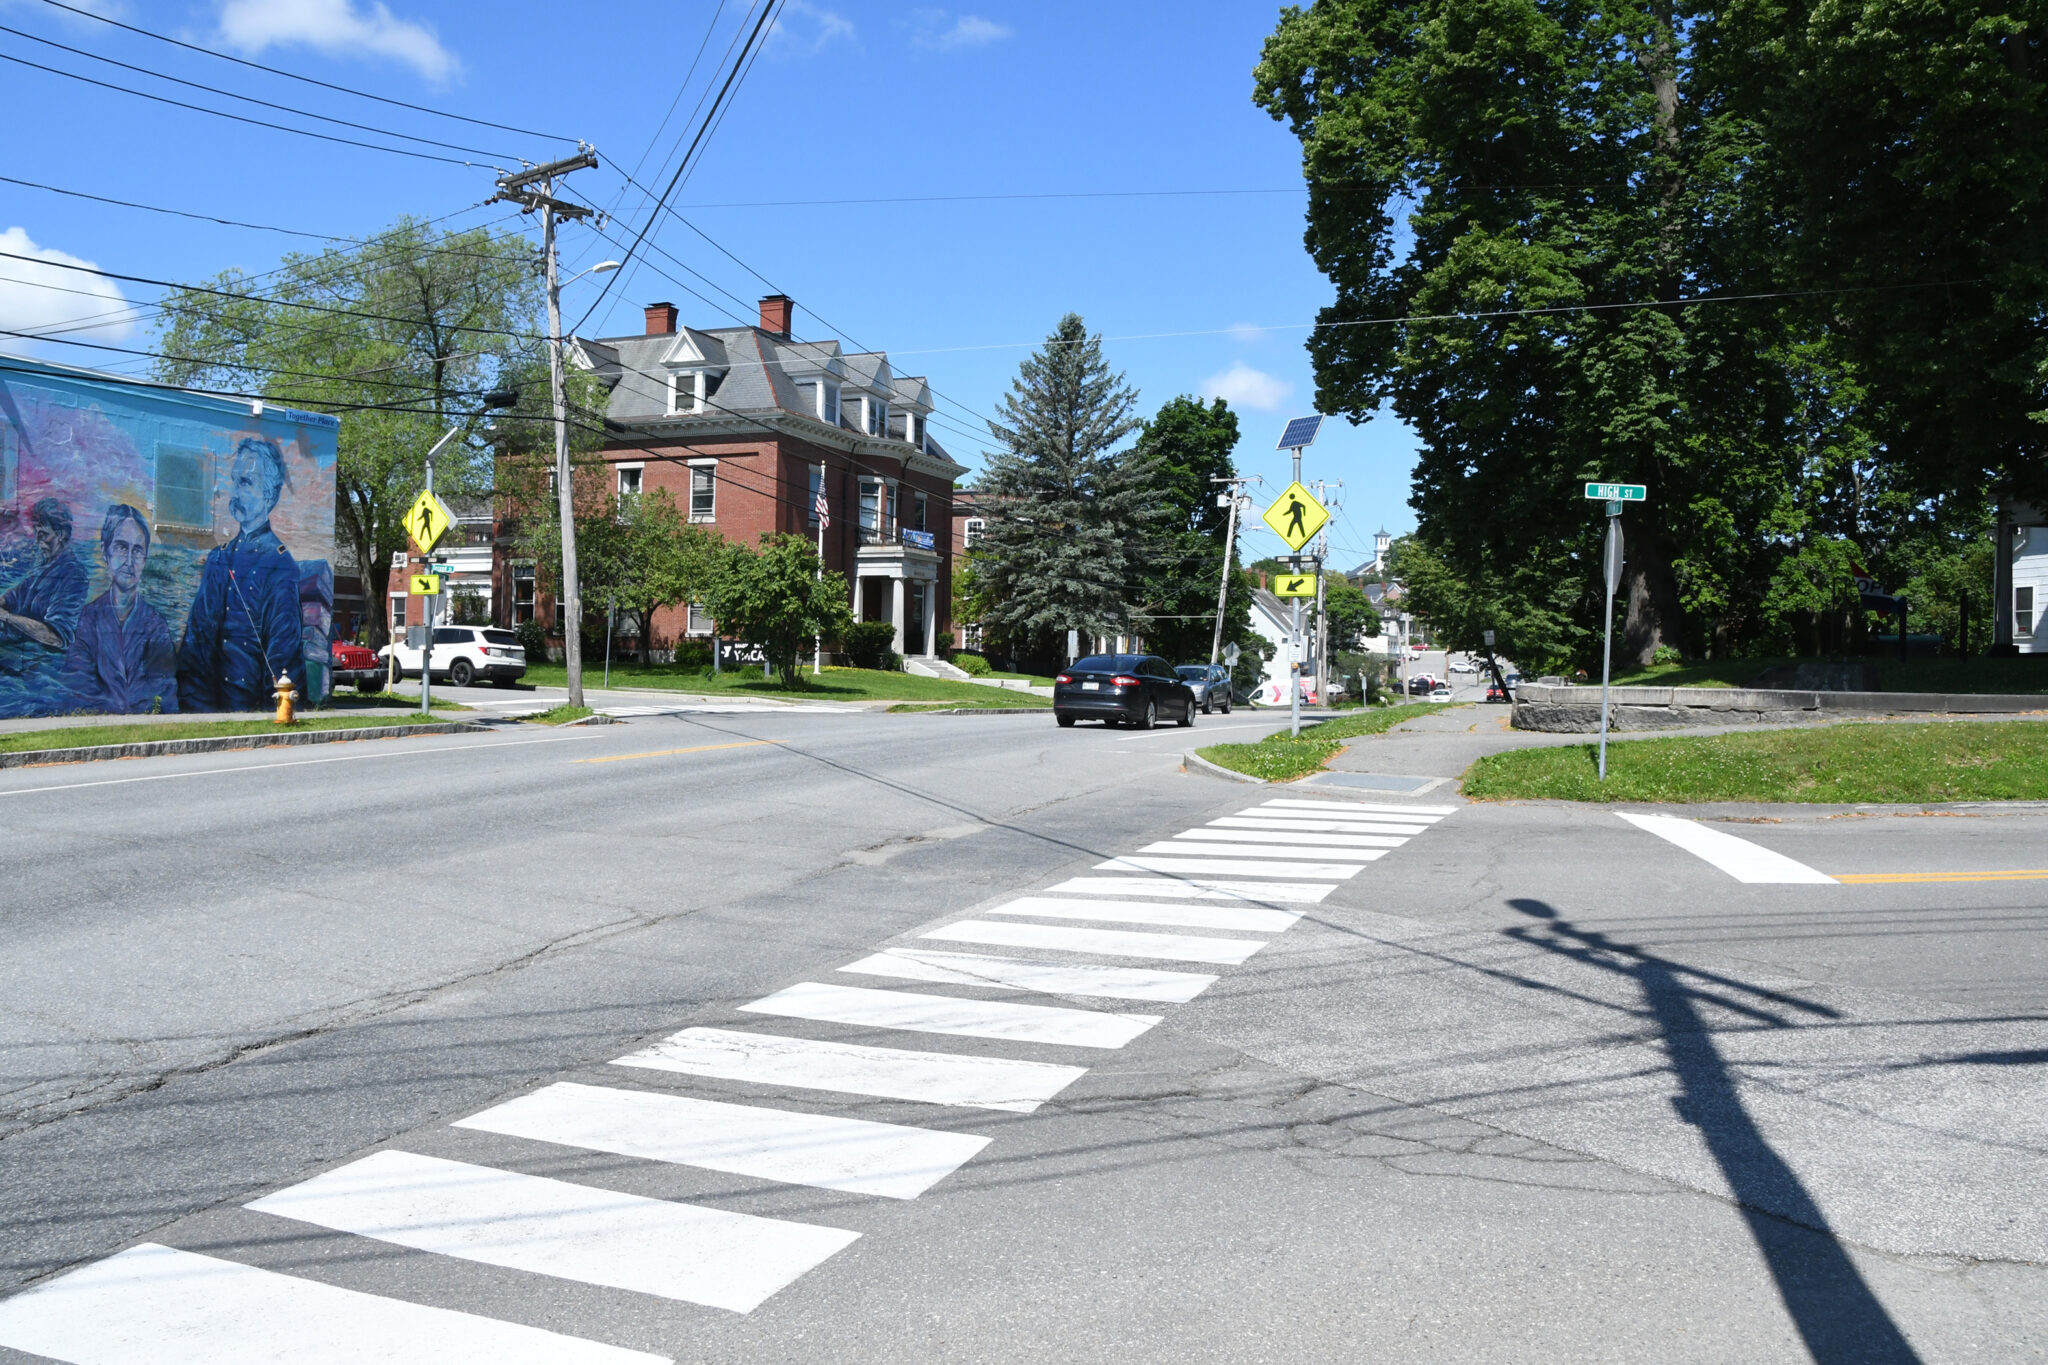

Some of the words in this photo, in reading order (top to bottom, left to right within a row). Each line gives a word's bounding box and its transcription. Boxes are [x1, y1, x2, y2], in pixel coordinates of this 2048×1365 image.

[289, 411, 317, 423] Together
[1597, 485, 1620, 497] HIGH
[1624, 489, 1633, 498] ST
